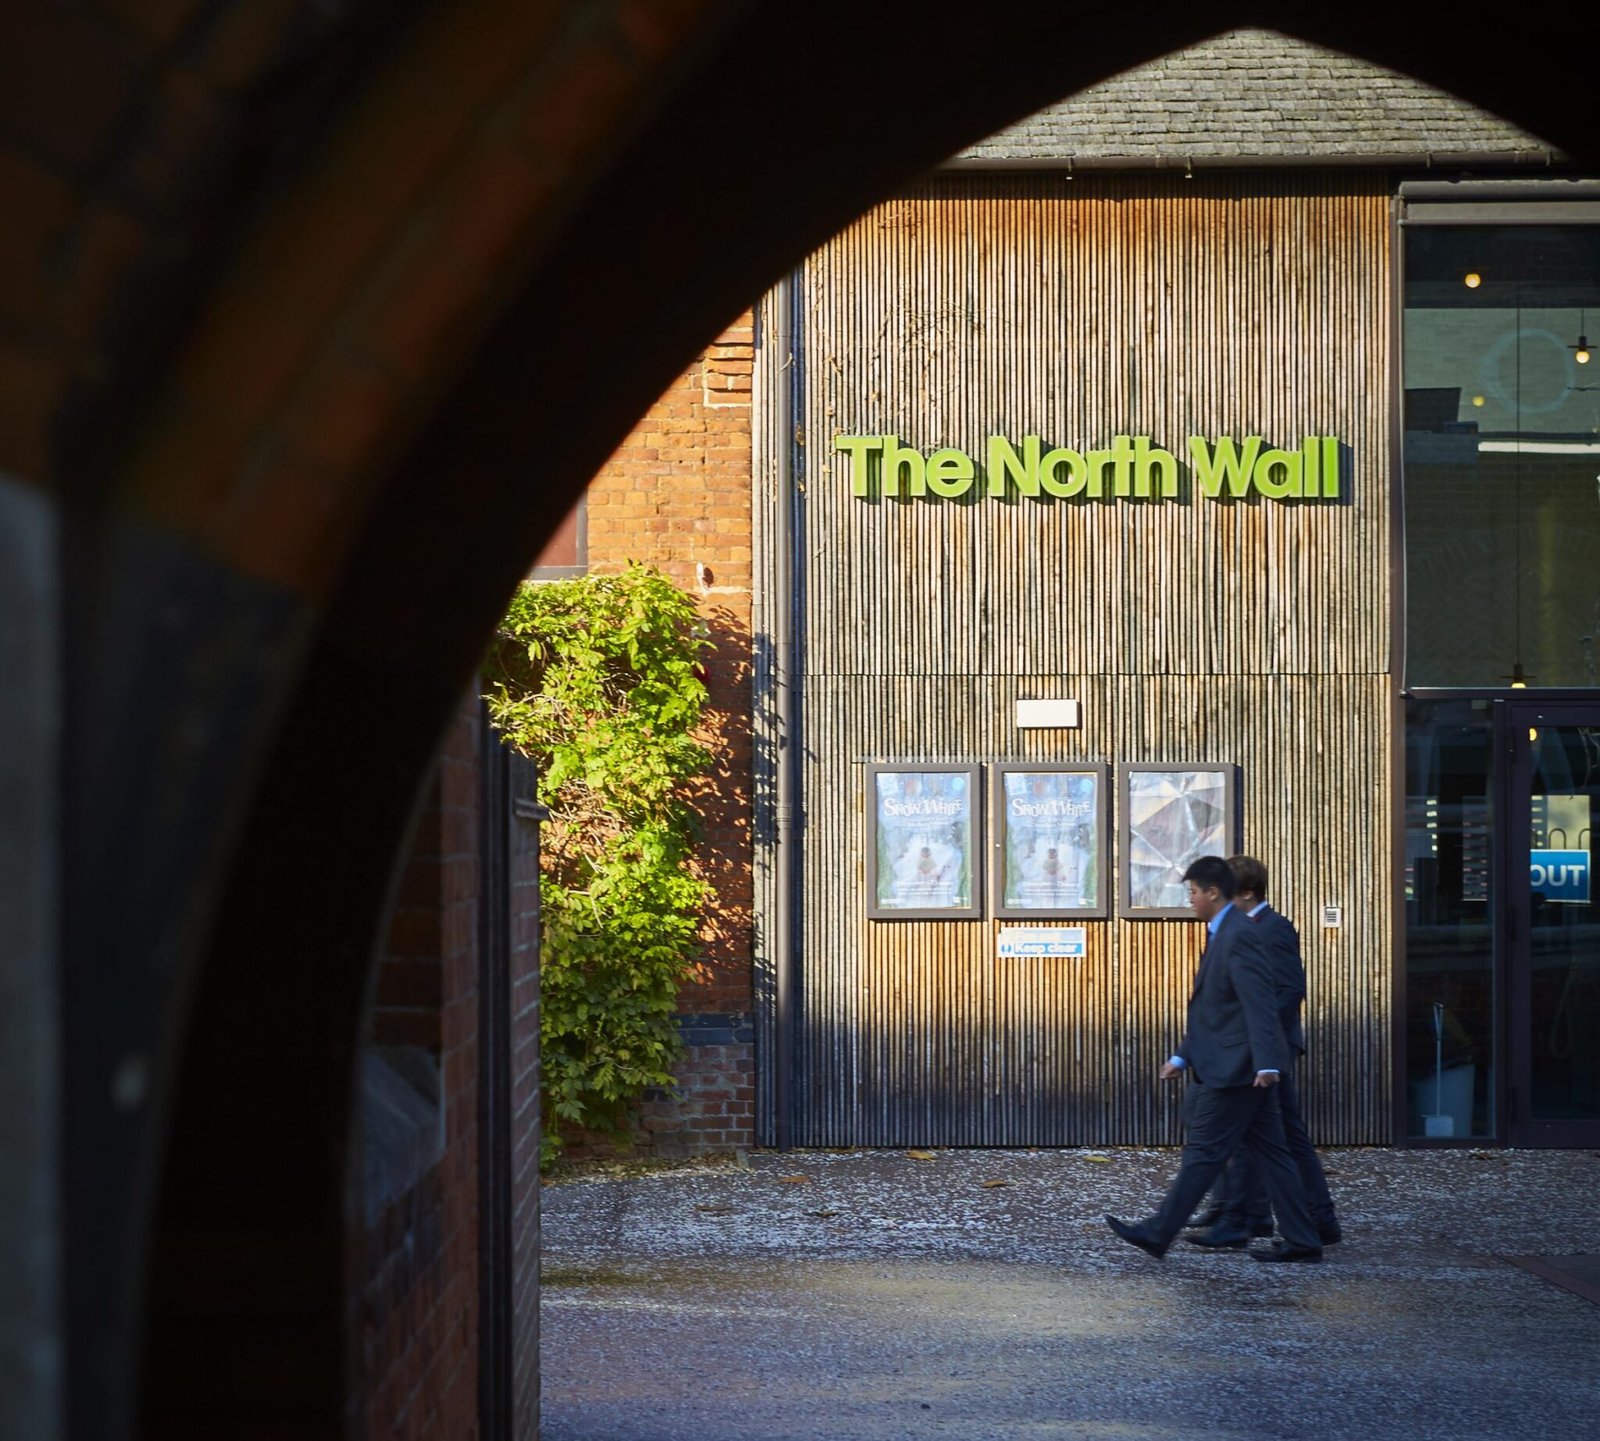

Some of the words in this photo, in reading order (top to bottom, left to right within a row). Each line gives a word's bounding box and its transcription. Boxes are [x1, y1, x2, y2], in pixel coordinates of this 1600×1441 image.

[836, 434, 974, 498] The
[988, 434, 1178, 499] North
[1189, 435, 1339, 499] Wall
[1530, 864, 1586, 887] OUT
